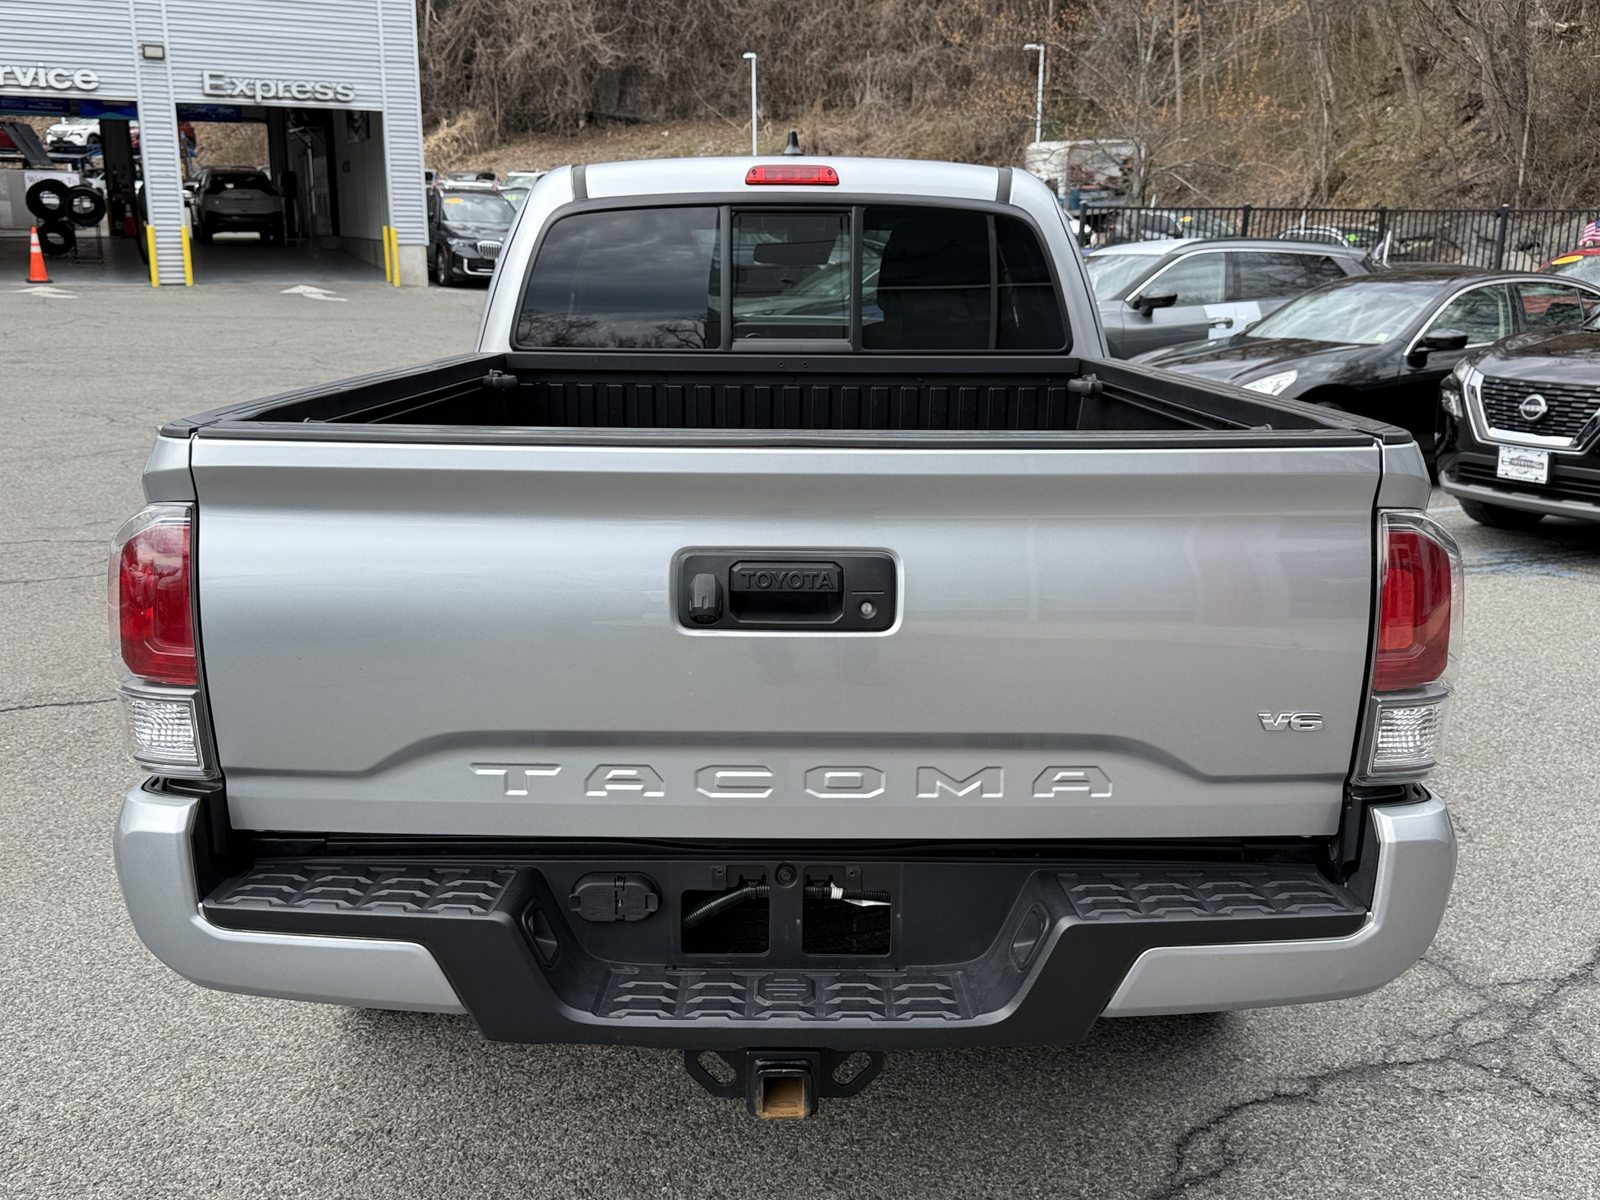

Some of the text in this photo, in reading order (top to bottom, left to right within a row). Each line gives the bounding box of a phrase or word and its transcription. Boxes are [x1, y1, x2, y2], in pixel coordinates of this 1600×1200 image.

[202, 70, 356, 103] Express
[740, 570, 834, 590] TOYOTA
[1257, 711, 1323, 732] V6
[469, 762, 1113, 798] TACOMA
